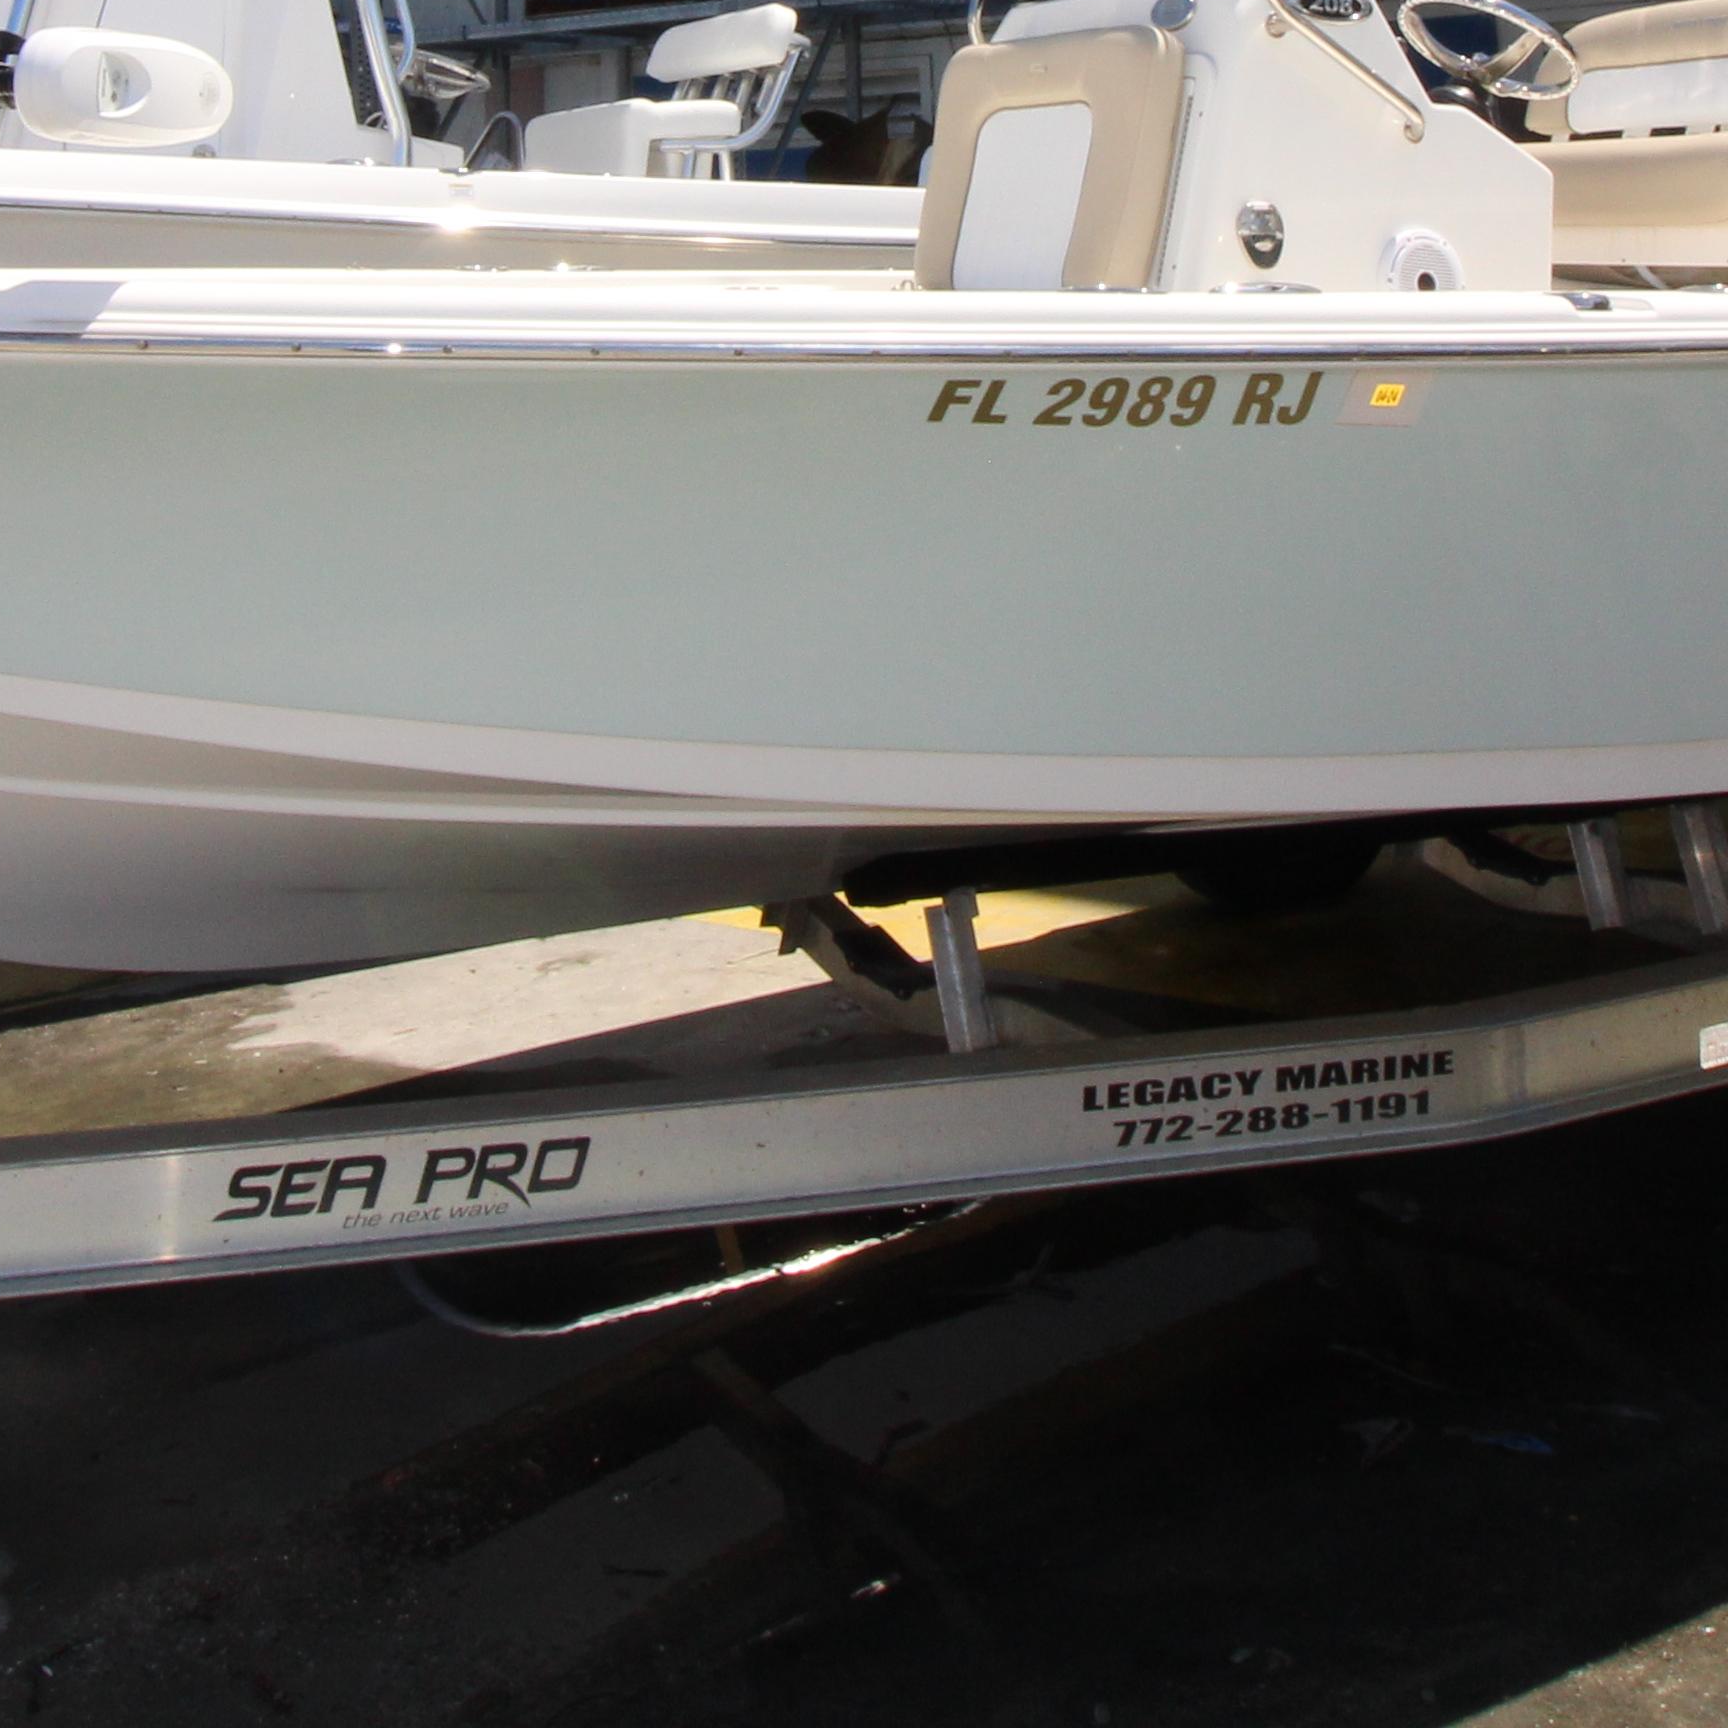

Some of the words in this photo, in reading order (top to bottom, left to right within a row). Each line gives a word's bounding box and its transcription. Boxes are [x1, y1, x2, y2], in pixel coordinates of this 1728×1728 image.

[927, 379, 1007, 424] FL
[1032, 374, 1217, 427] 2989
[1232, 371, 1324, 426] RJ
[1082, 1070, 1262, 1112] LEGACY
[1276, 1050, 1455, 1092] MARINE
[1113, 1089, 1431, 1147] 772-288-1191
[212, 1154, 387, 1222] SEA
[414, 1136, 591, 1208] PRO
[342, 1213, 382, 1230] the
[390, 1207, 441, 1224] next
[449, 1201, 509, 1220] wave
